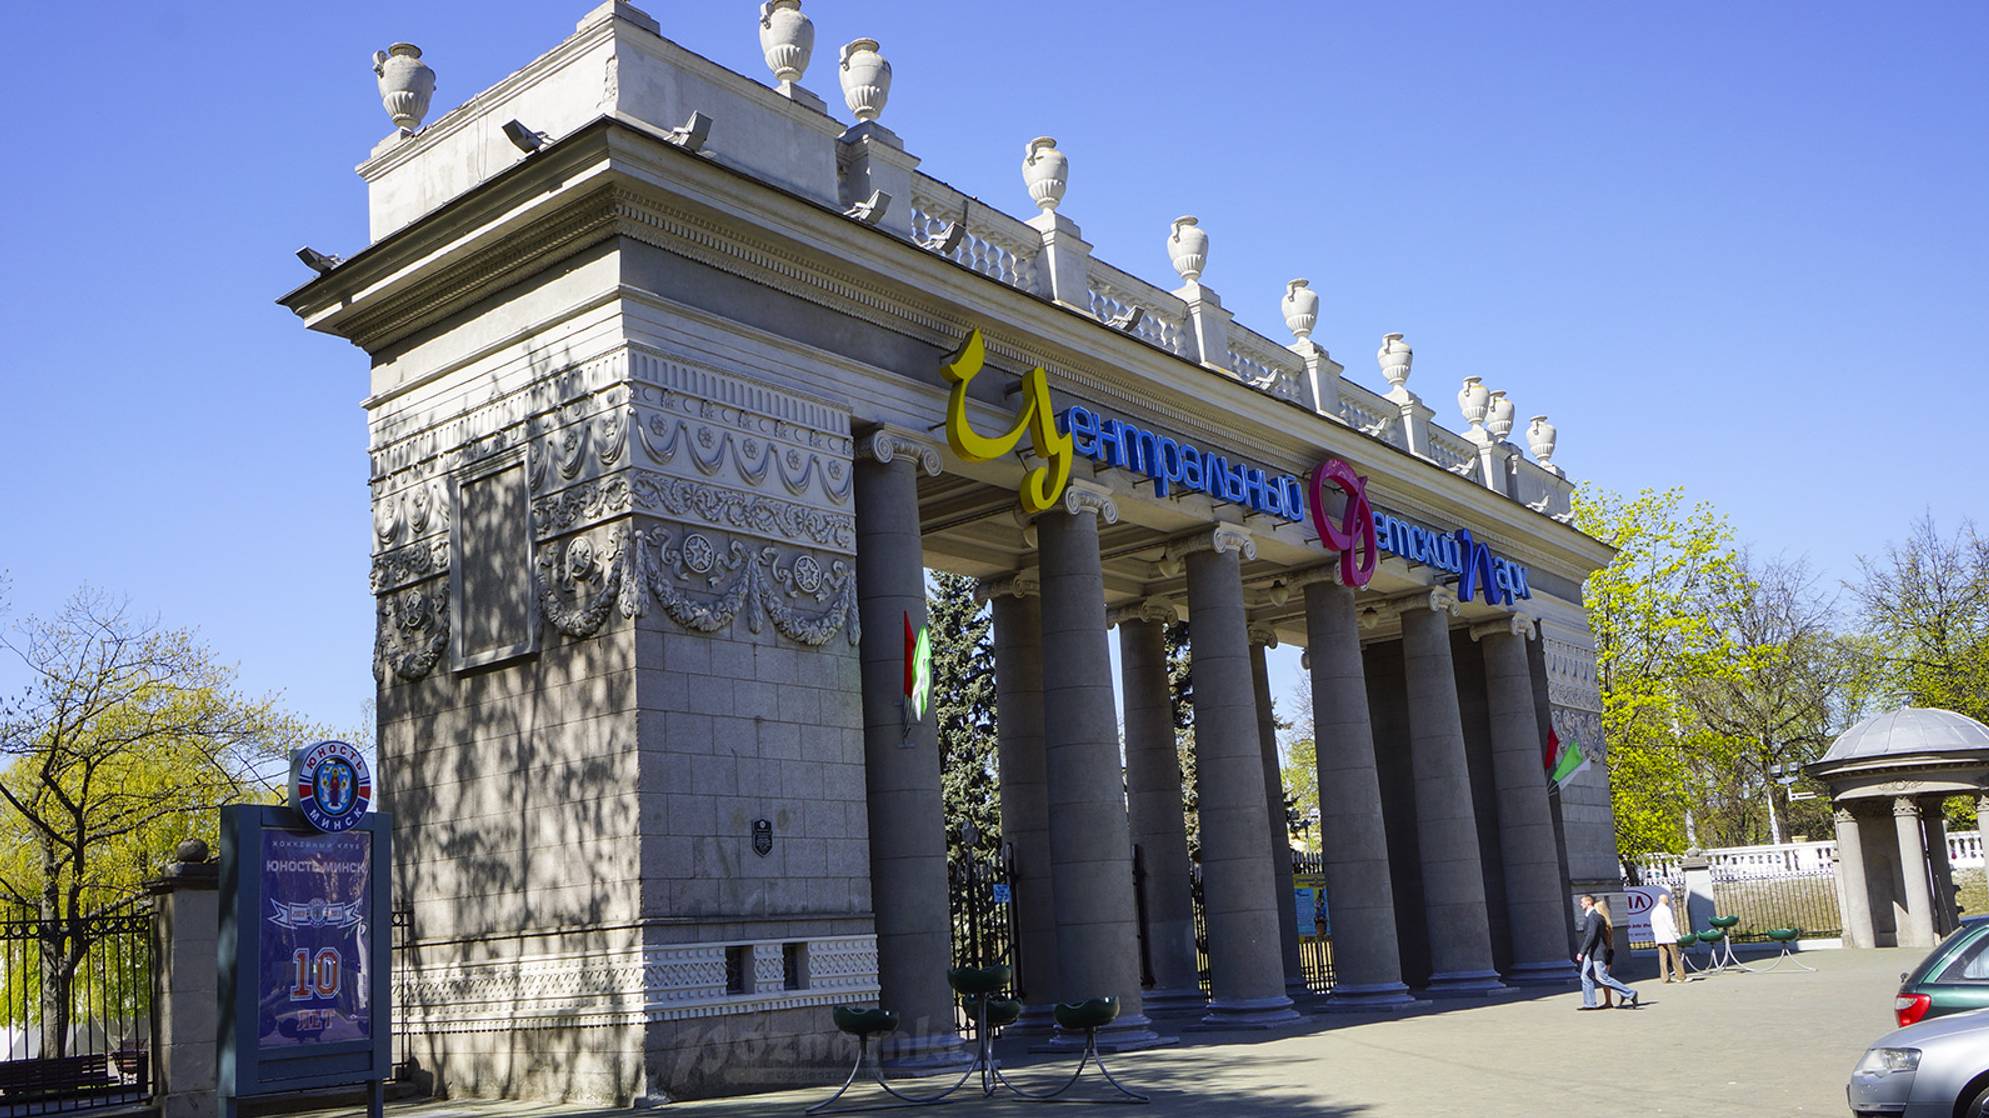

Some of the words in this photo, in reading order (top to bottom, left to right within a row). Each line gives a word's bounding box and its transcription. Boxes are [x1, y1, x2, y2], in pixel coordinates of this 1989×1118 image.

[306, 744, 362, 770] ЮНОСТЬ
[309, 807, 363, 830] МИНСК
[290, 947, 342, 1001] 10
